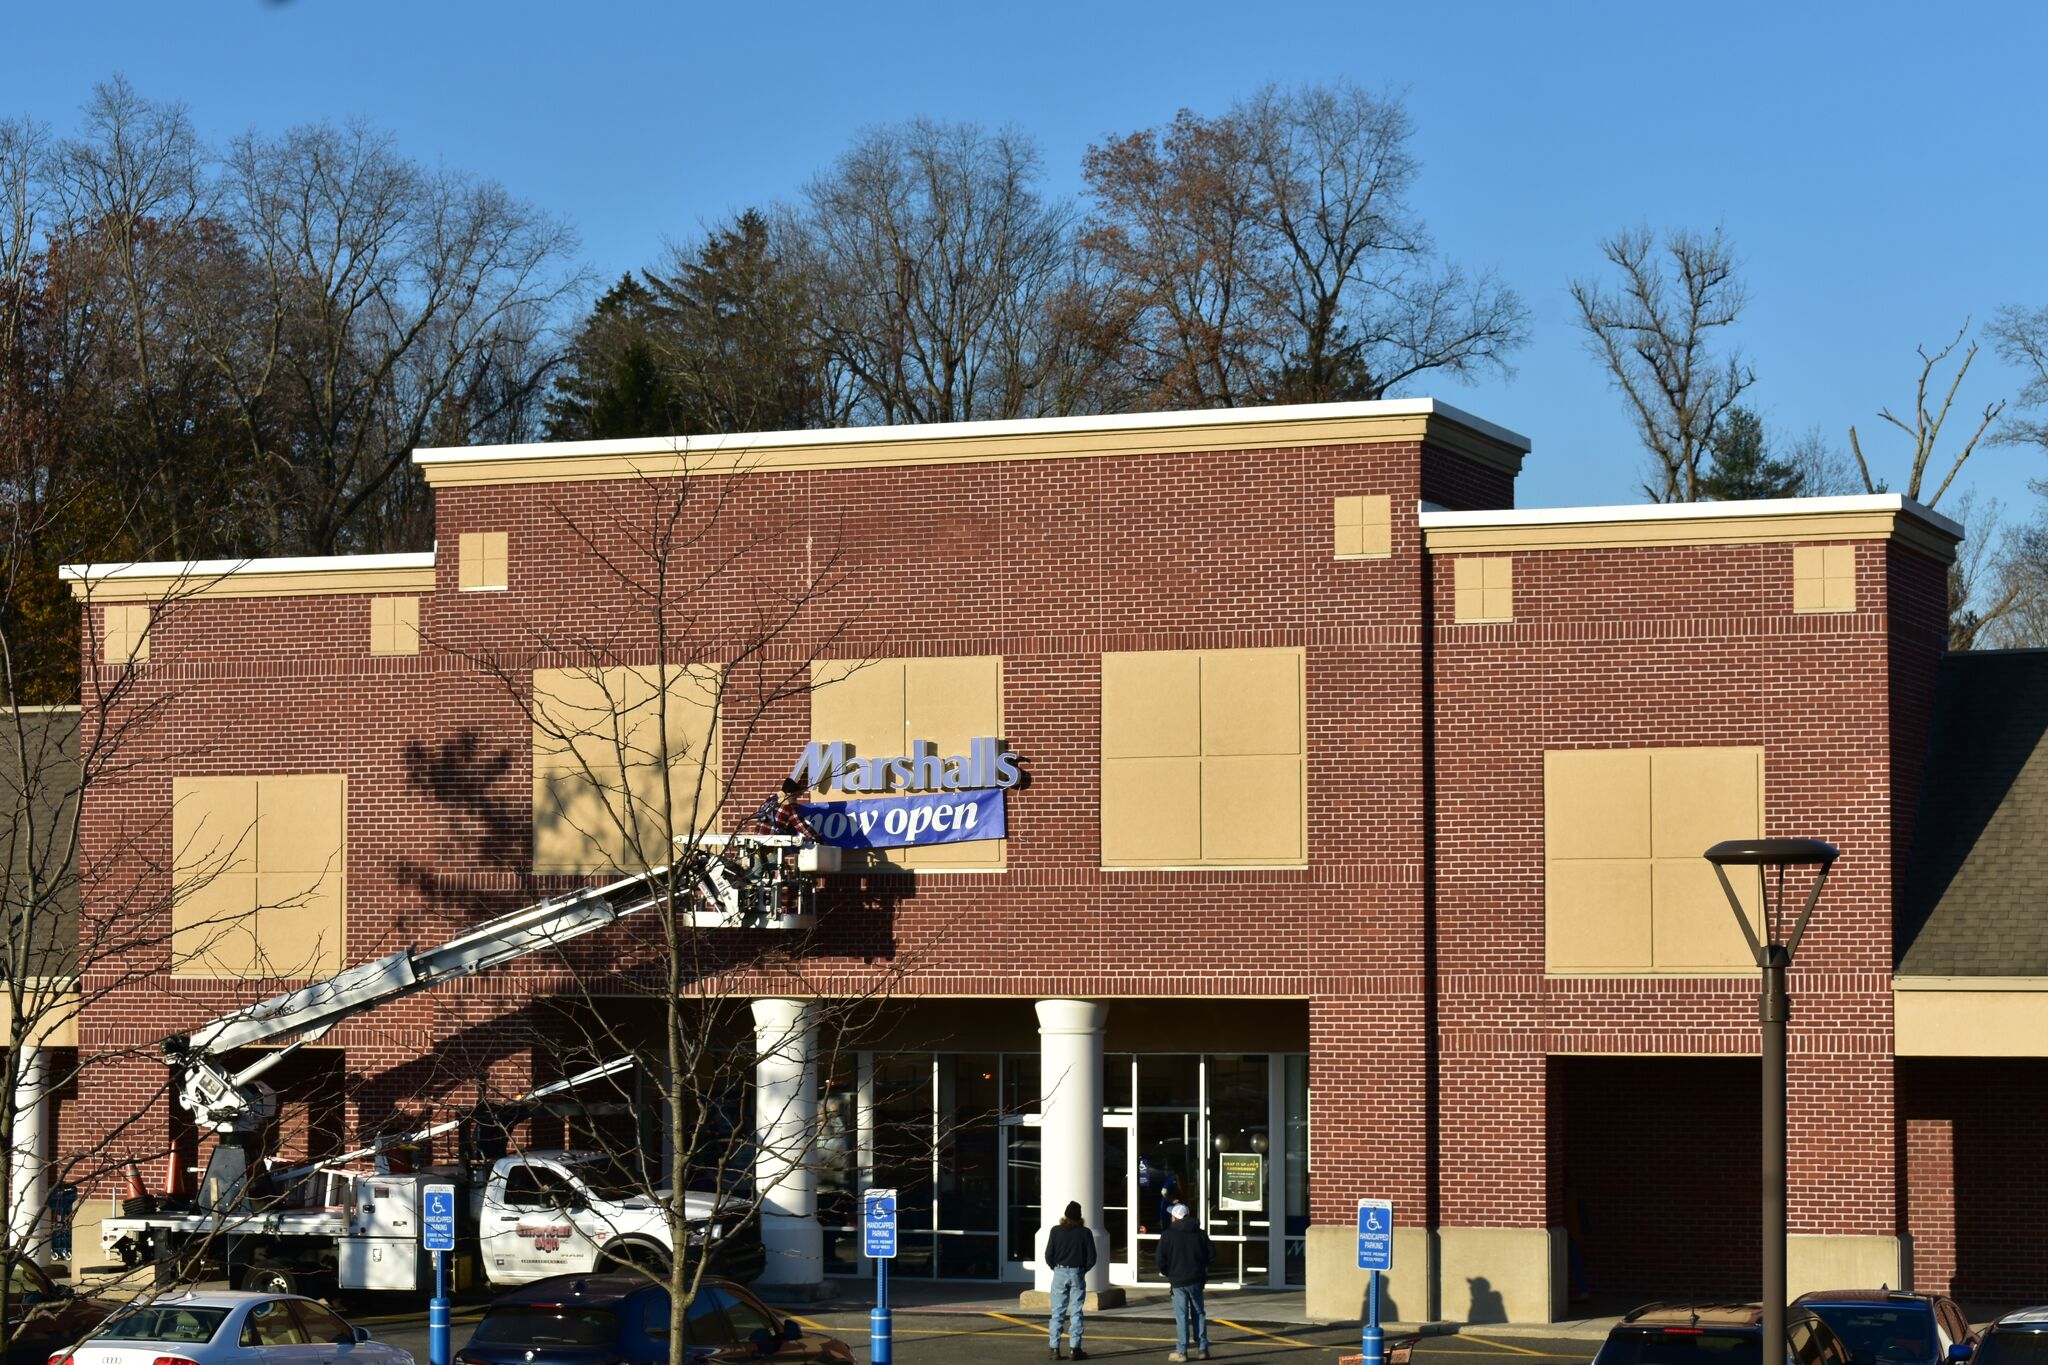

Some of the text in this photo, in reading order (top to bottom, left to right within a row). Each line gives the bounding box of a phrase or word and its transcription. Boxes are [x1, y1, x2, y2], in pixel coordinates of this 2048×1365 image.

[792, 737, 1021, 791] Marshalls
[805, 801, 979, 842] now open
[1360, 1232, 1389, 1241] HANDICAPPED
[1364, 1241, 1384, 1250] PARKING
